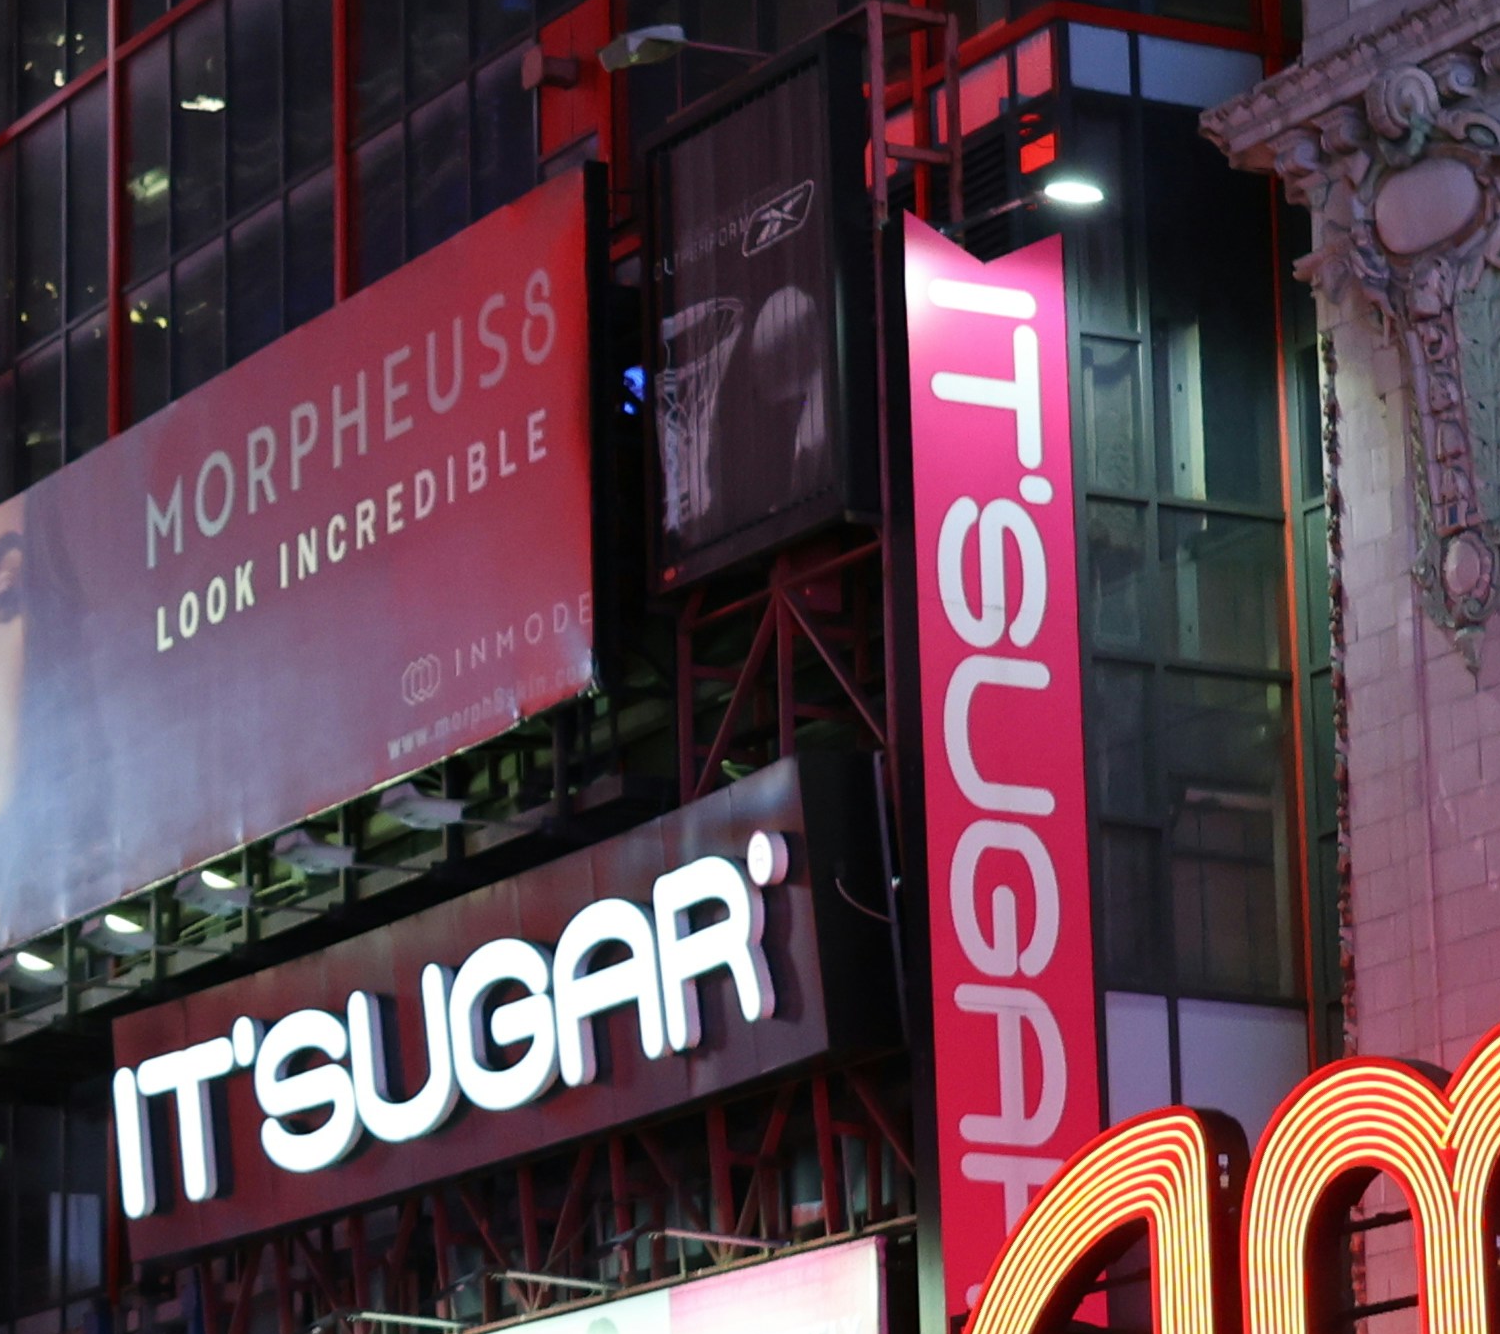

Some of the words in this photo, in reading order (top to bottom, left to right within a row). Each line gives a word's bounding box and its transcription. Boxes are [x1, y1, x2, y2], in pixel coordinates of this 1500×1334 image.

[144, 270, 557, 569] MORPHEUS8
[156, 558, 256, 654] LOOK
[279, 408, 548, 588] INCREDIBLE
[455, 591, 593, 677] INMODE
[113, 855, 775, 1220] IT'SUGAR
